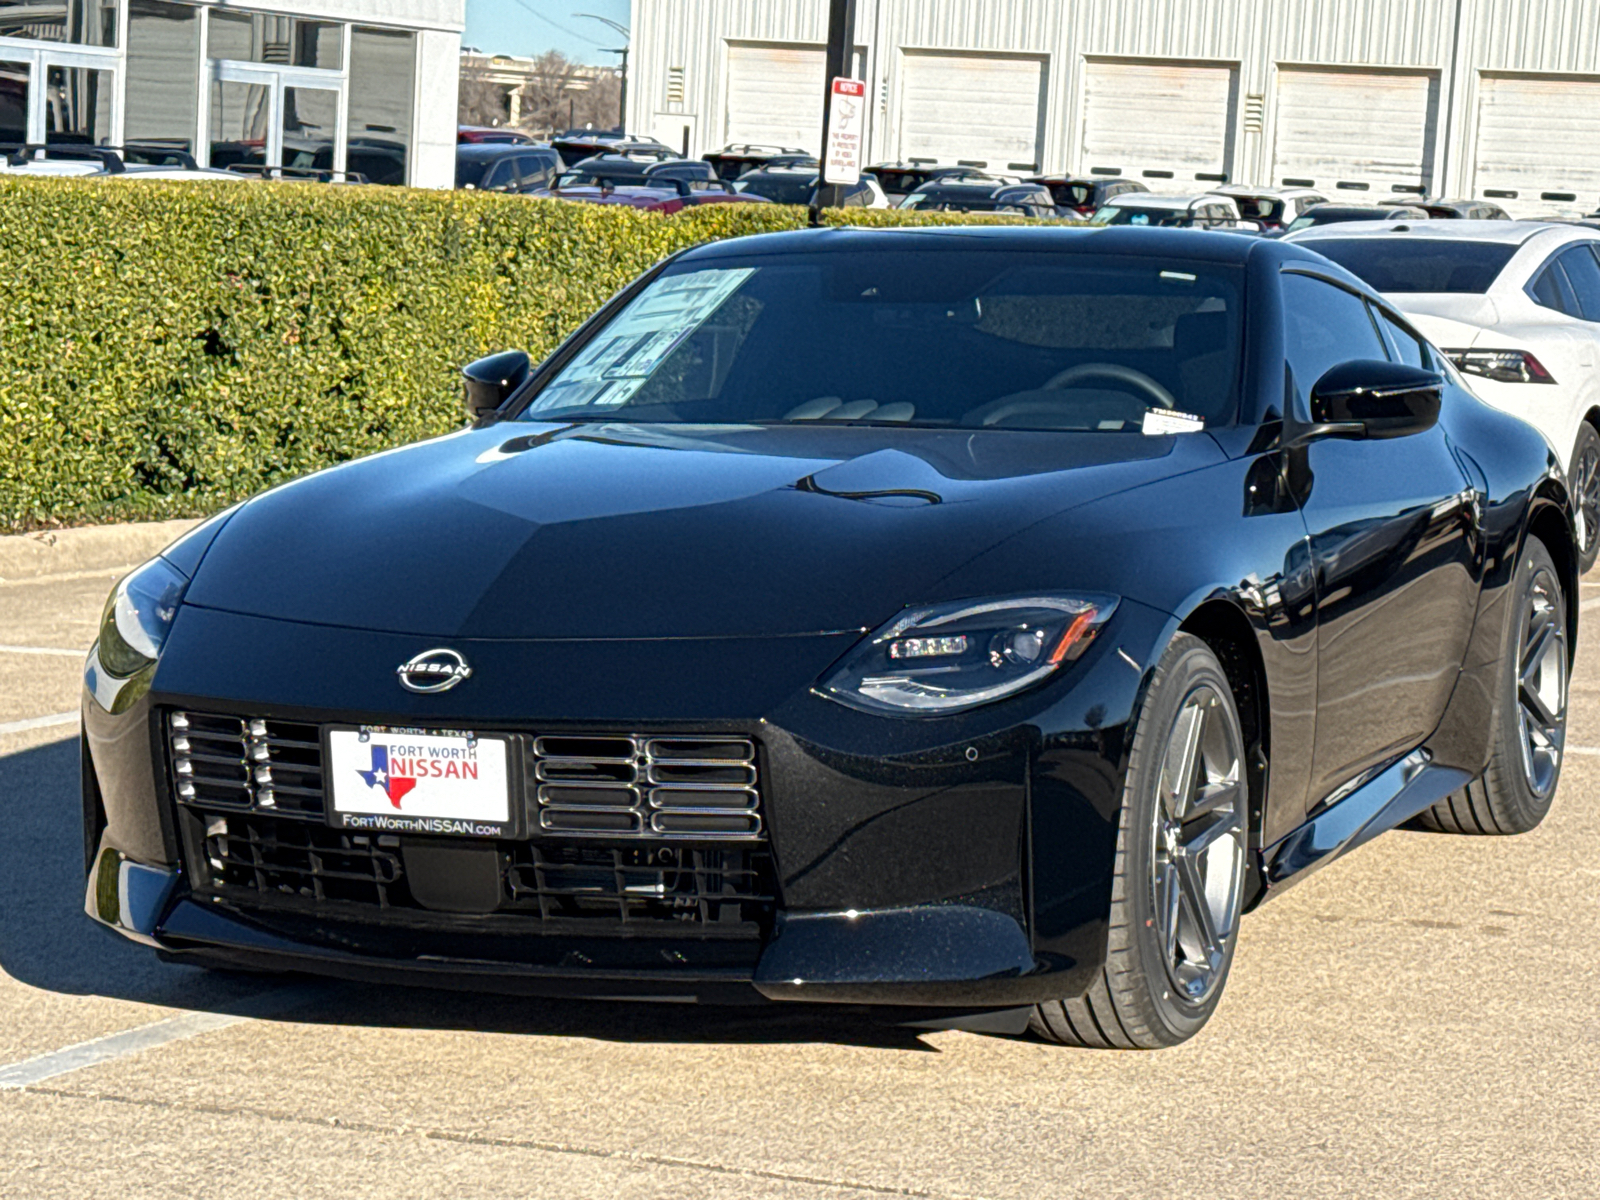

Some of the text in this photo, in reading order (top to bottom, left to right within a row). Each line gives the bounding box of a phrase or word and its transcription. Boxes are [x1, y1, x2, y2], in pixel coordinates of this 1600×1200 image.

[397, 662, 471, 678] NISSAN
[360, 725, 475, 739] FORT WORTH TEXAS
[389, 744, 478, 760] FORT WORTH
[390, 757, 479, 780] NISSAN
